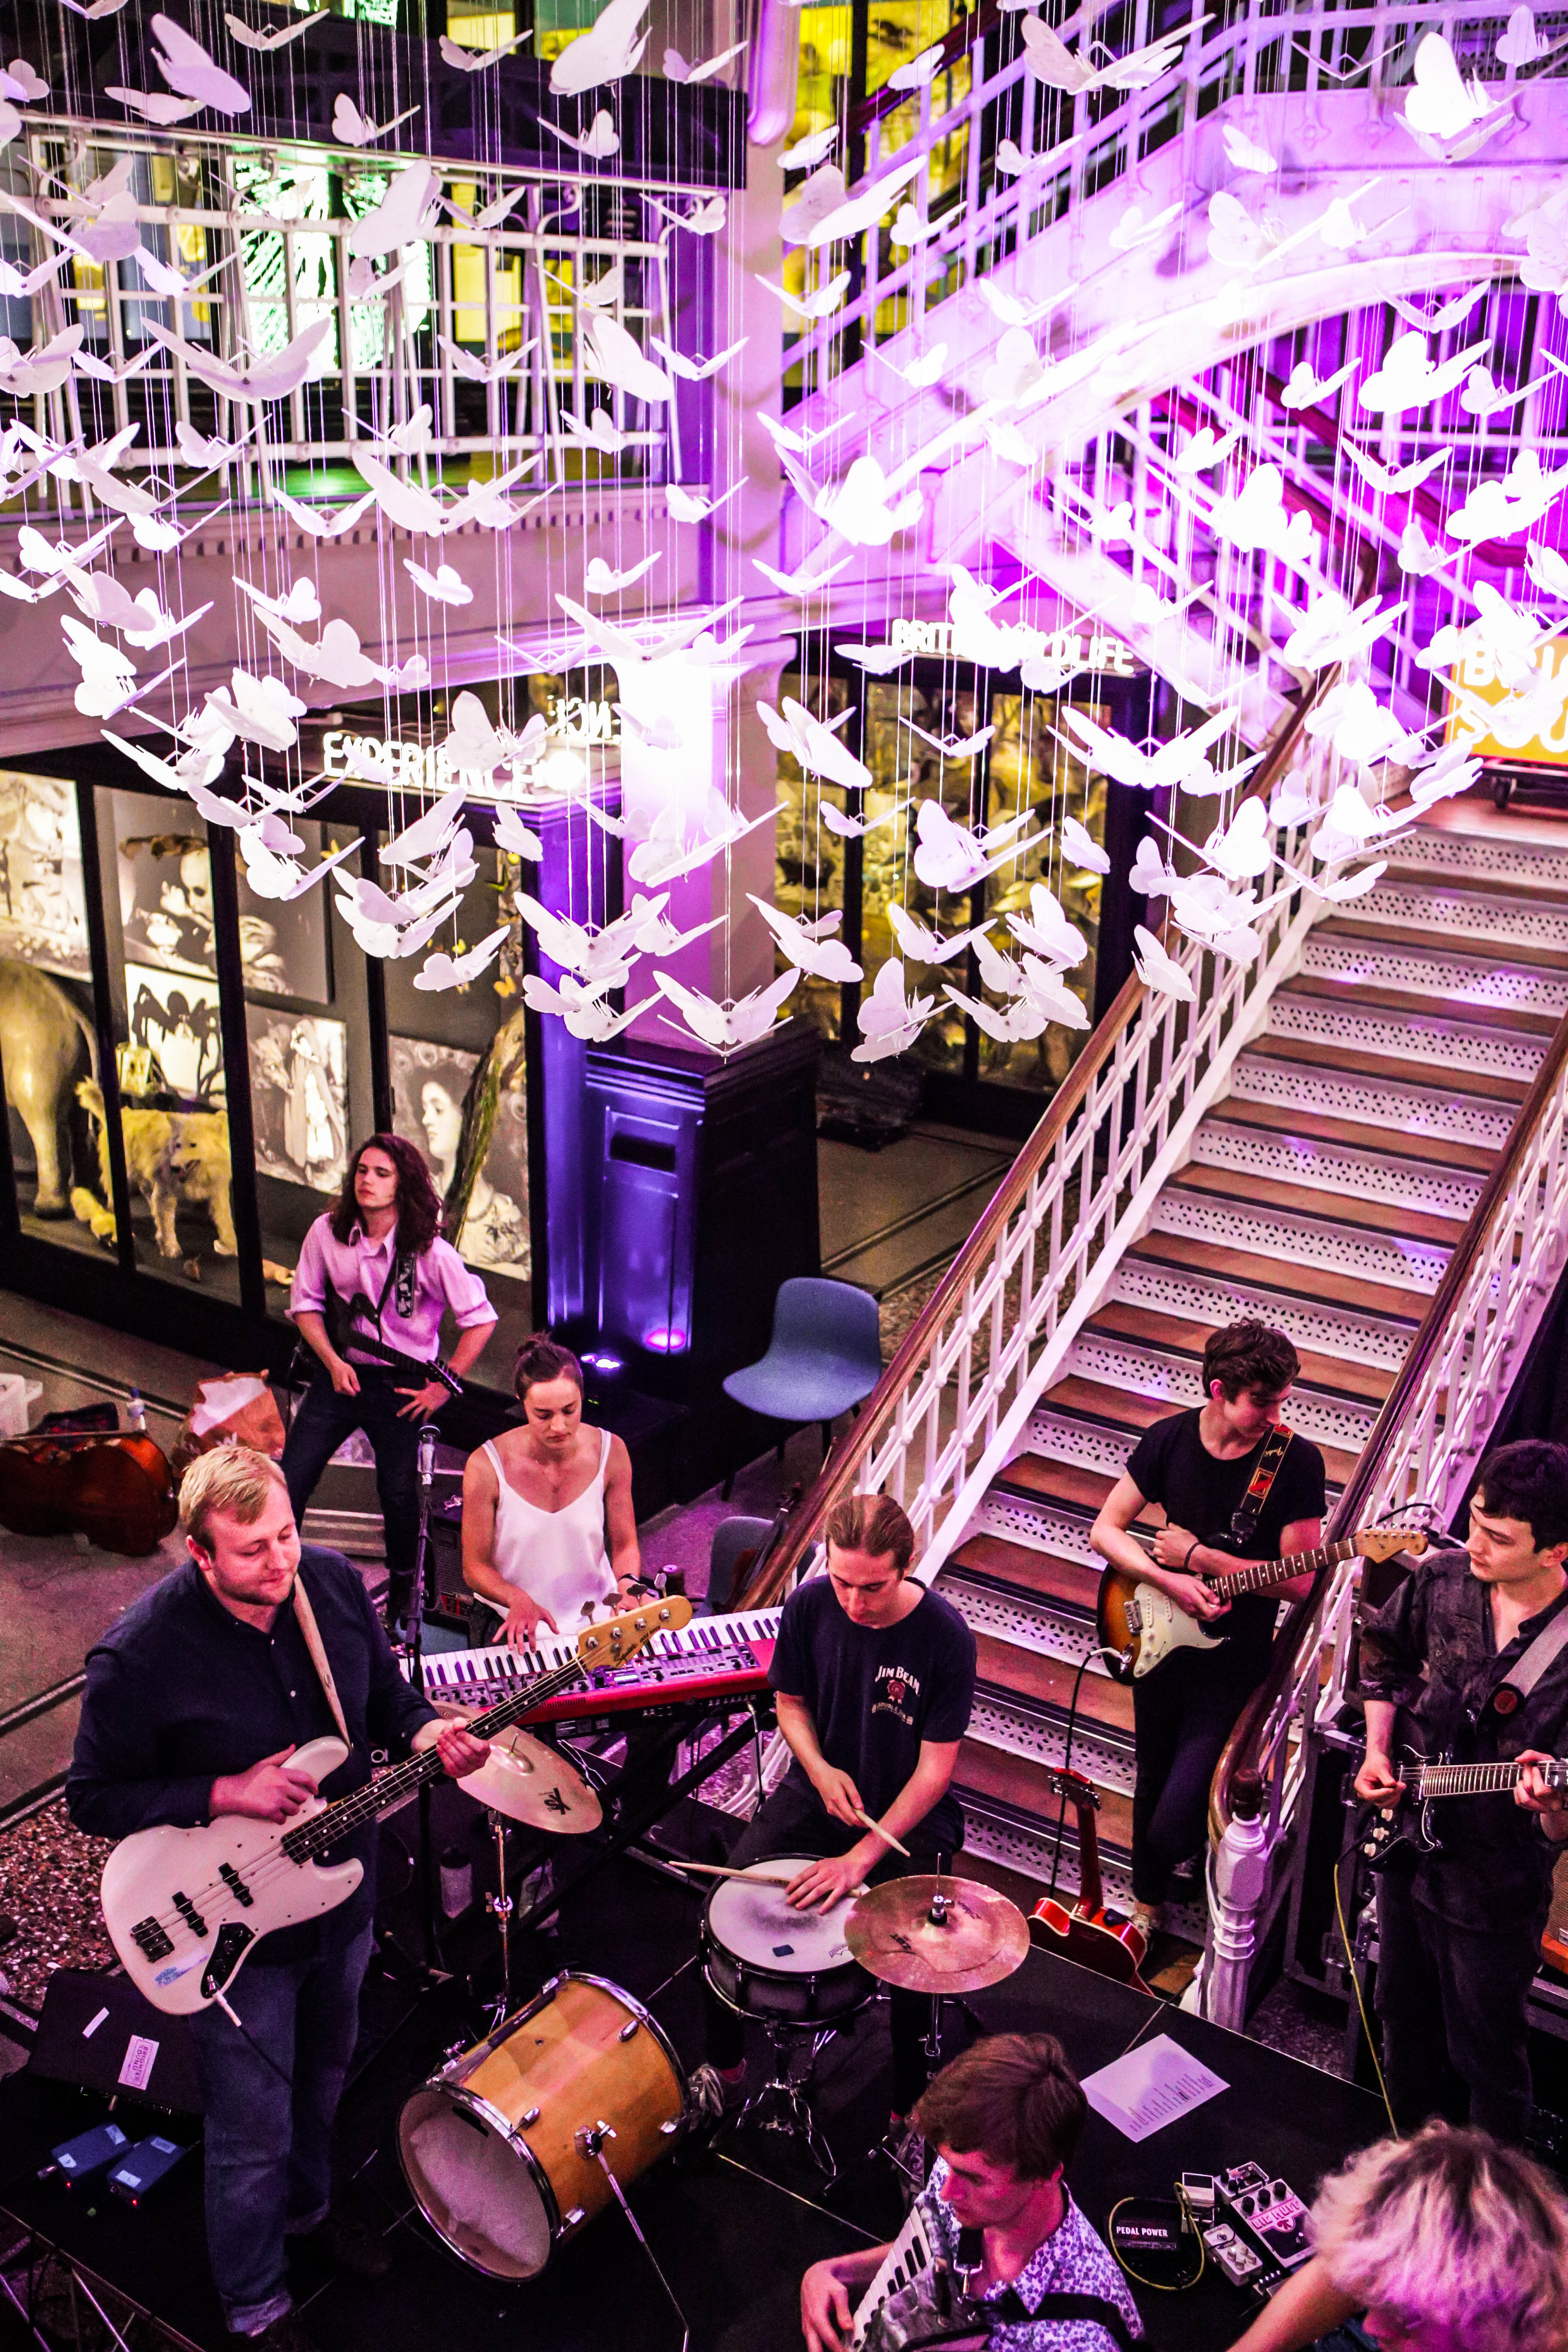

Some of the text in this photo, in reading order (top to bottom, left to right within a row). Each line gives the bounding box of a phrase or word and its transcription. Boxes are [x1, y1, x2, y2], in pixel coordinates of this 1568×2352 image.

[324, 732, 536, 804] EXPERIENCE
[875, 1665, 920, 1695] JIM BEAM
[1116, 2226, 1168, 2237] PEDAL POWER
